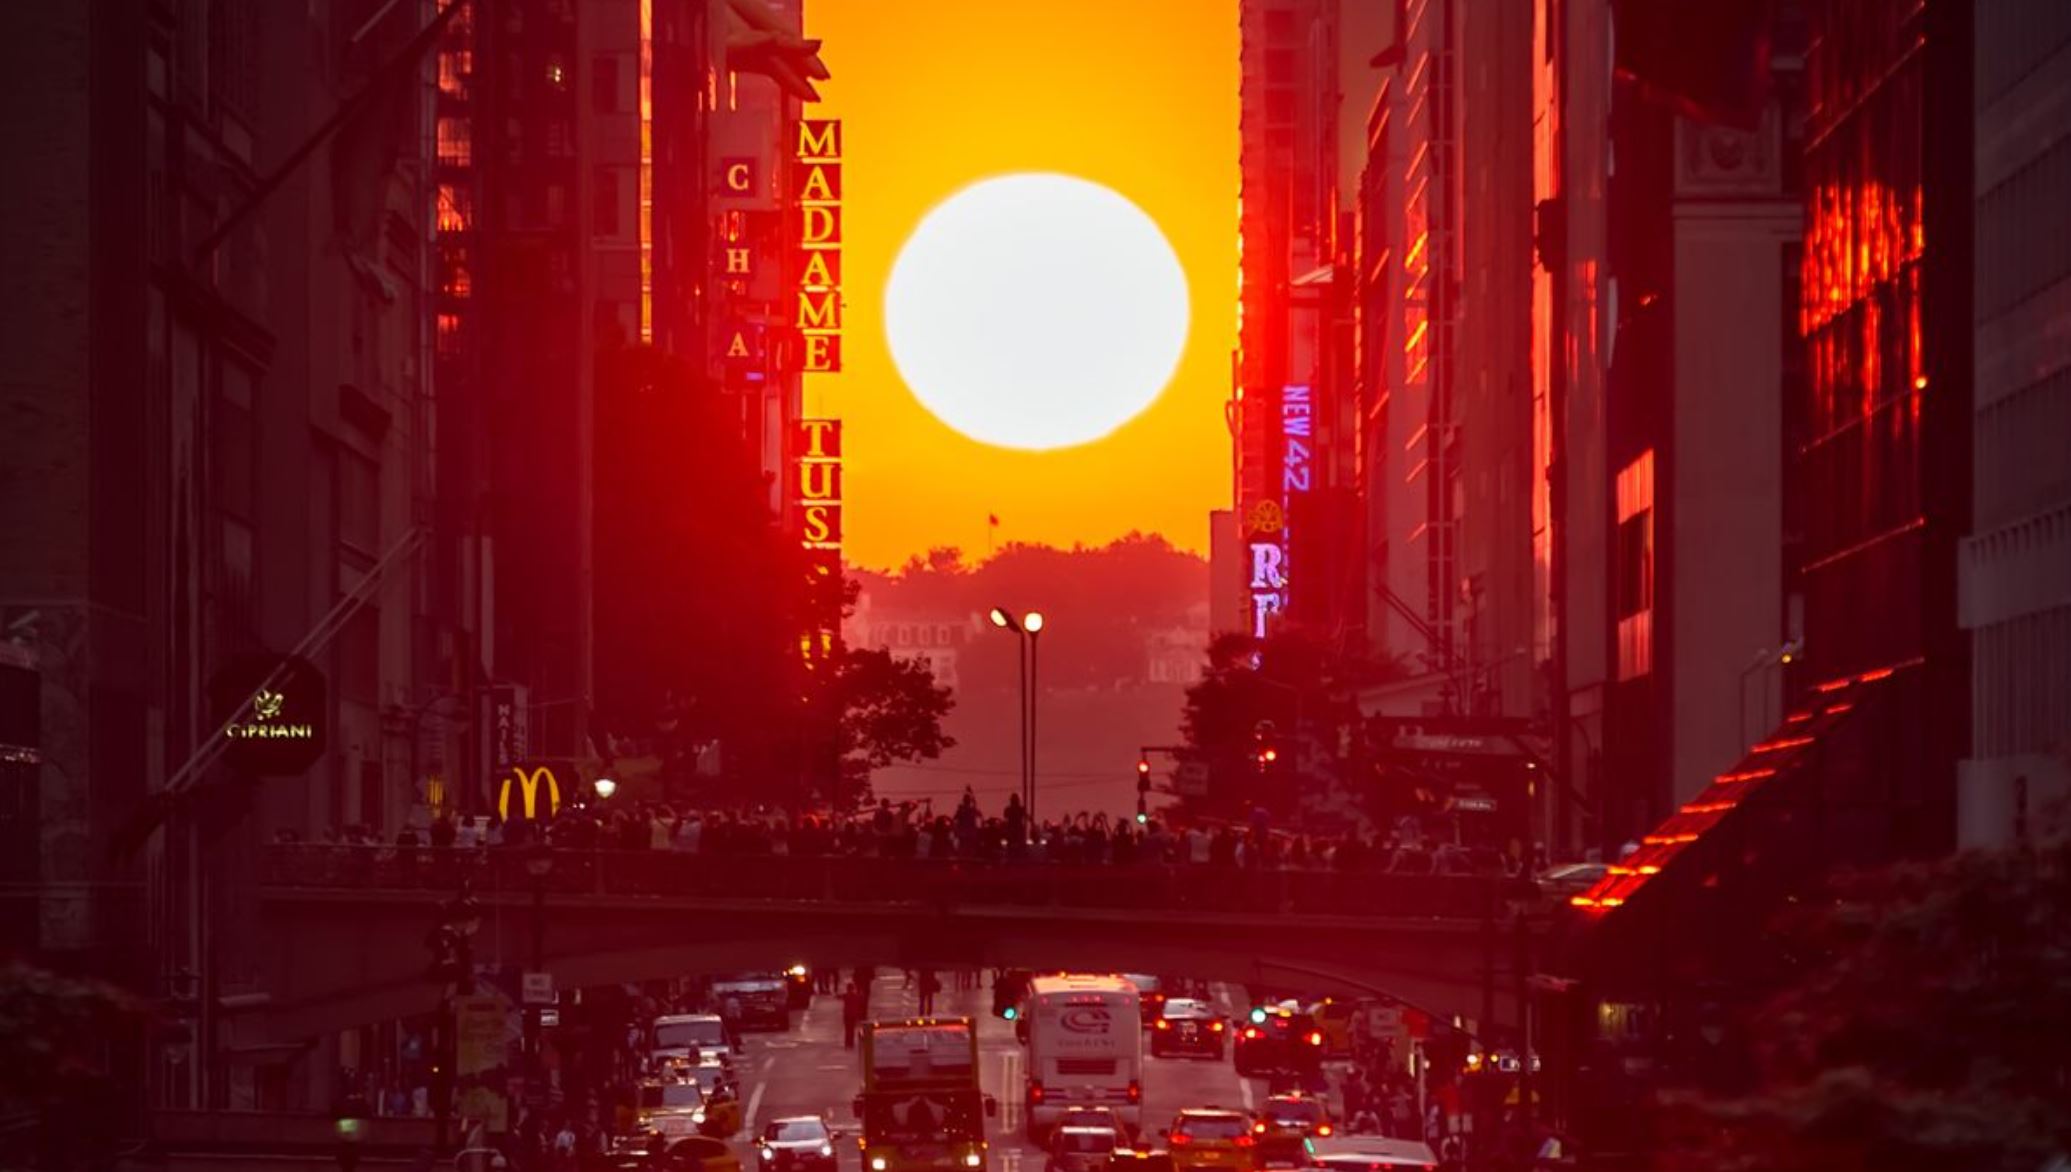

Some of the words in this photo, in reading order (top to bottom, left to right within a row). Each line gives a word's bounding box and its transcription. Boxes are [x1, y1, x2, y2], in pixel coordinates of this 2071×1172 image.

[798, 121, 838, 370] MADAME
[801, 422, 836, 572] TUS
[227, 723, 312, 738] CIPRIANI
